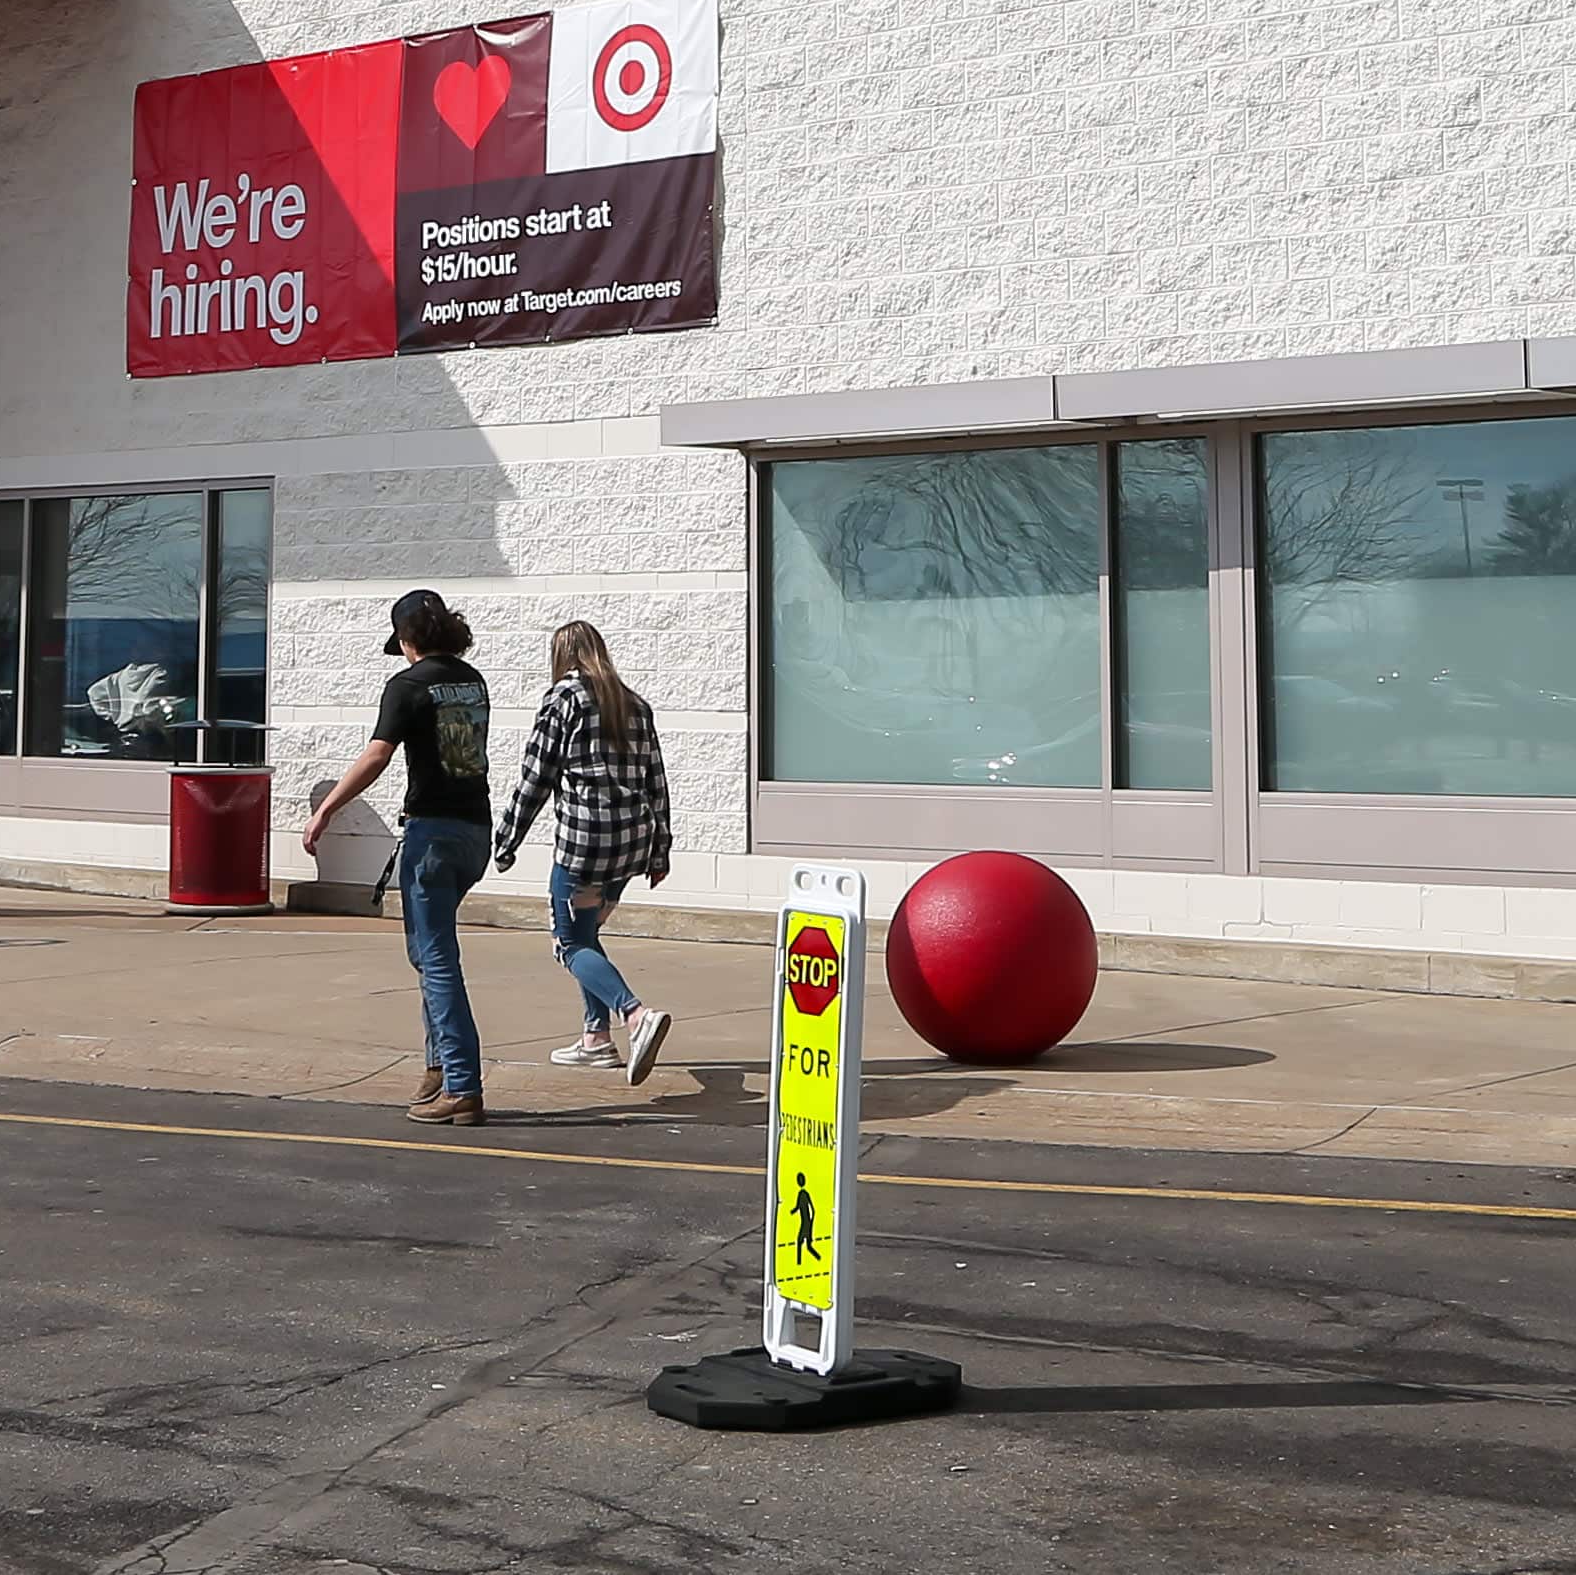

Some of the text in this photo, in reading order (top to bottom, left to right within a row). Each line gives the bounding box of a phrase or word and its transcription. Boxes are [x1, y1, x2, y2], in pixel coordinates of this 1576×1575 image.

[153, 173, 306, 254] We're
[422, 200, 612, 249] Positions start at
[421, 252, 518, 285] $15/hour.
[150, 259, 318, 345] hiring.
[422, 279, 682, 325] Apply now at Target.com/careers
[789, 954, 837, 987] STOP
[788, 1043, 831, 1079] FOR
